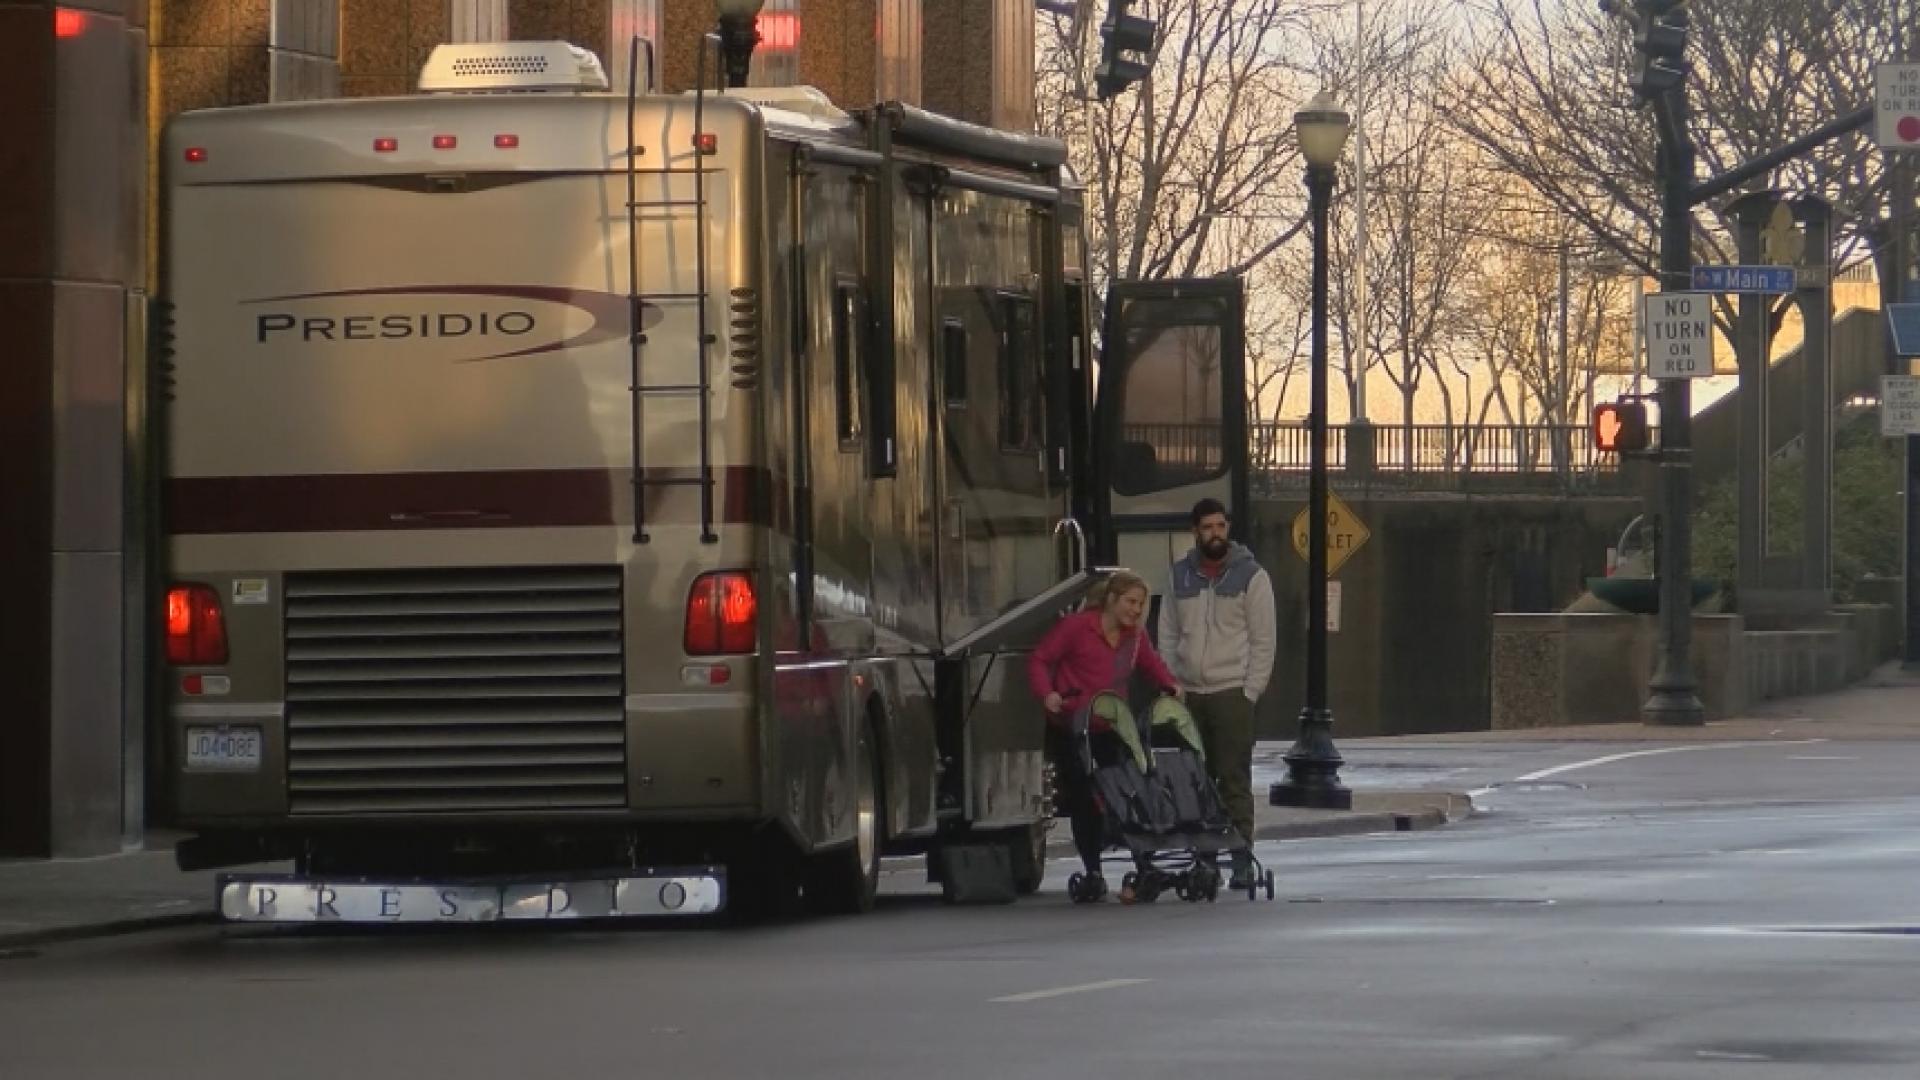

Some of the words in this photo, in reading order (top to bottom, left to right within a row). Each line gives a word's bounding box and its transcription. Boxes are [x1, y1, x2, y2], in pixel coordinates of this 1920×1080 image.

[1890, 85, 1920, 97] TUR
[1727, 269, 1769, 289] Main
[1664, 299, 1691, 317] NO
[257, 311, 536, 344] PRESIDIO
[1653, 321, 1706, 340] TURN
[1669, 343, 1691, 356] ON
[1665, 359, 1695, 372] RED
[1298, 533, 1353, 549] OLET
[255, 880, 687, 918] PRESIDIO
